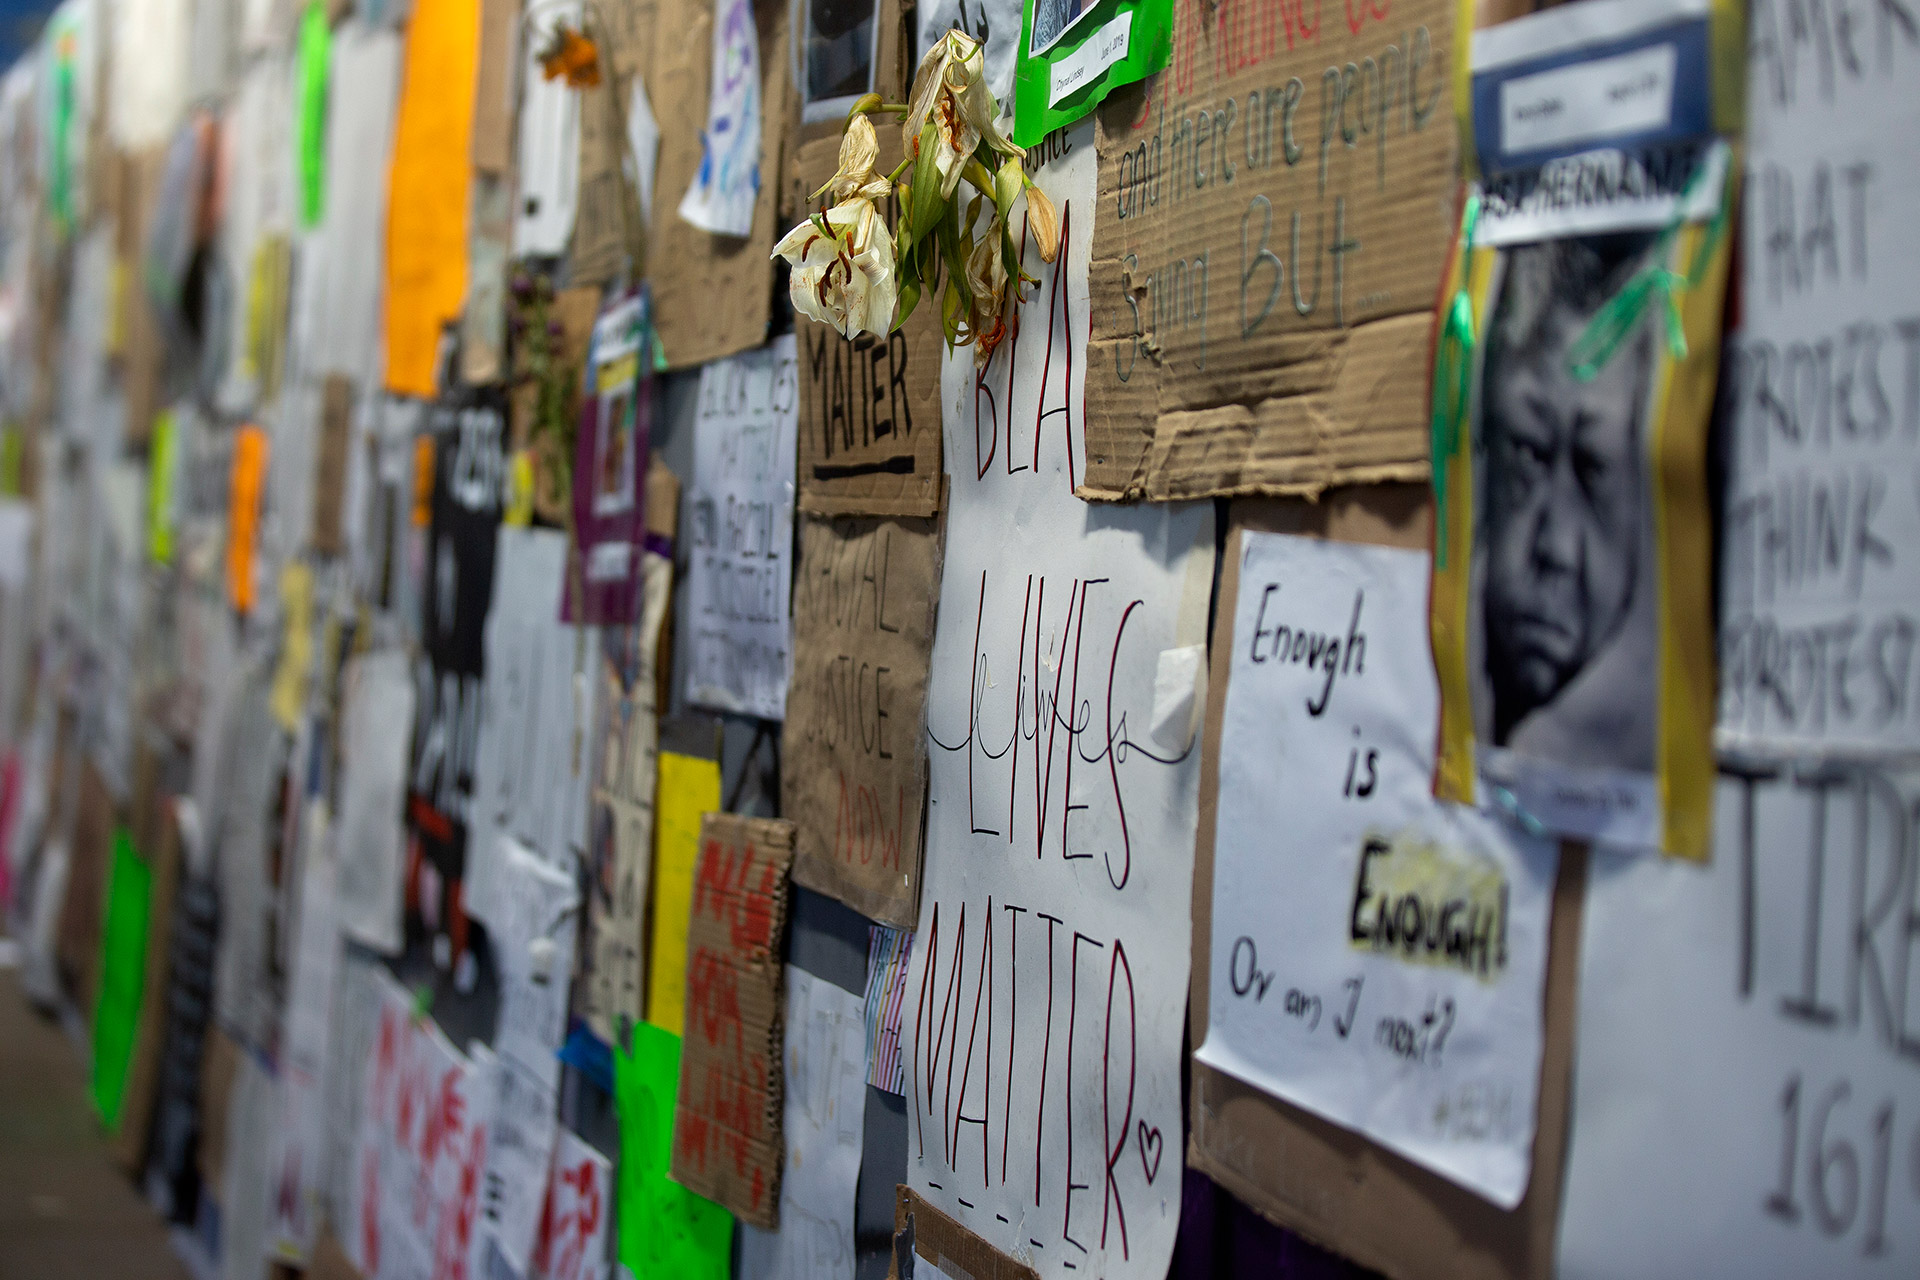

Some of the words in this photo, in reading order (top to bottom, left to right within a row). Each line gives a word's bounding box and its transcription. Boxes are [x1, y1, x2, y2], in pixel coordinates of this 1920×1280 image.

[1246, 76, 1305, 166] are
[1250, 582, 1367, 719] Enough
[969, 569, 1144, 890] LIVES
[1343, 723, 1380, 800] is
[833, 769, 905, 873] NOW
[1229, 934, 1276, 1004] Or
[914, 894, 1136, 1261] MATTER
[1762, 1070, 1920, 1262] 161
